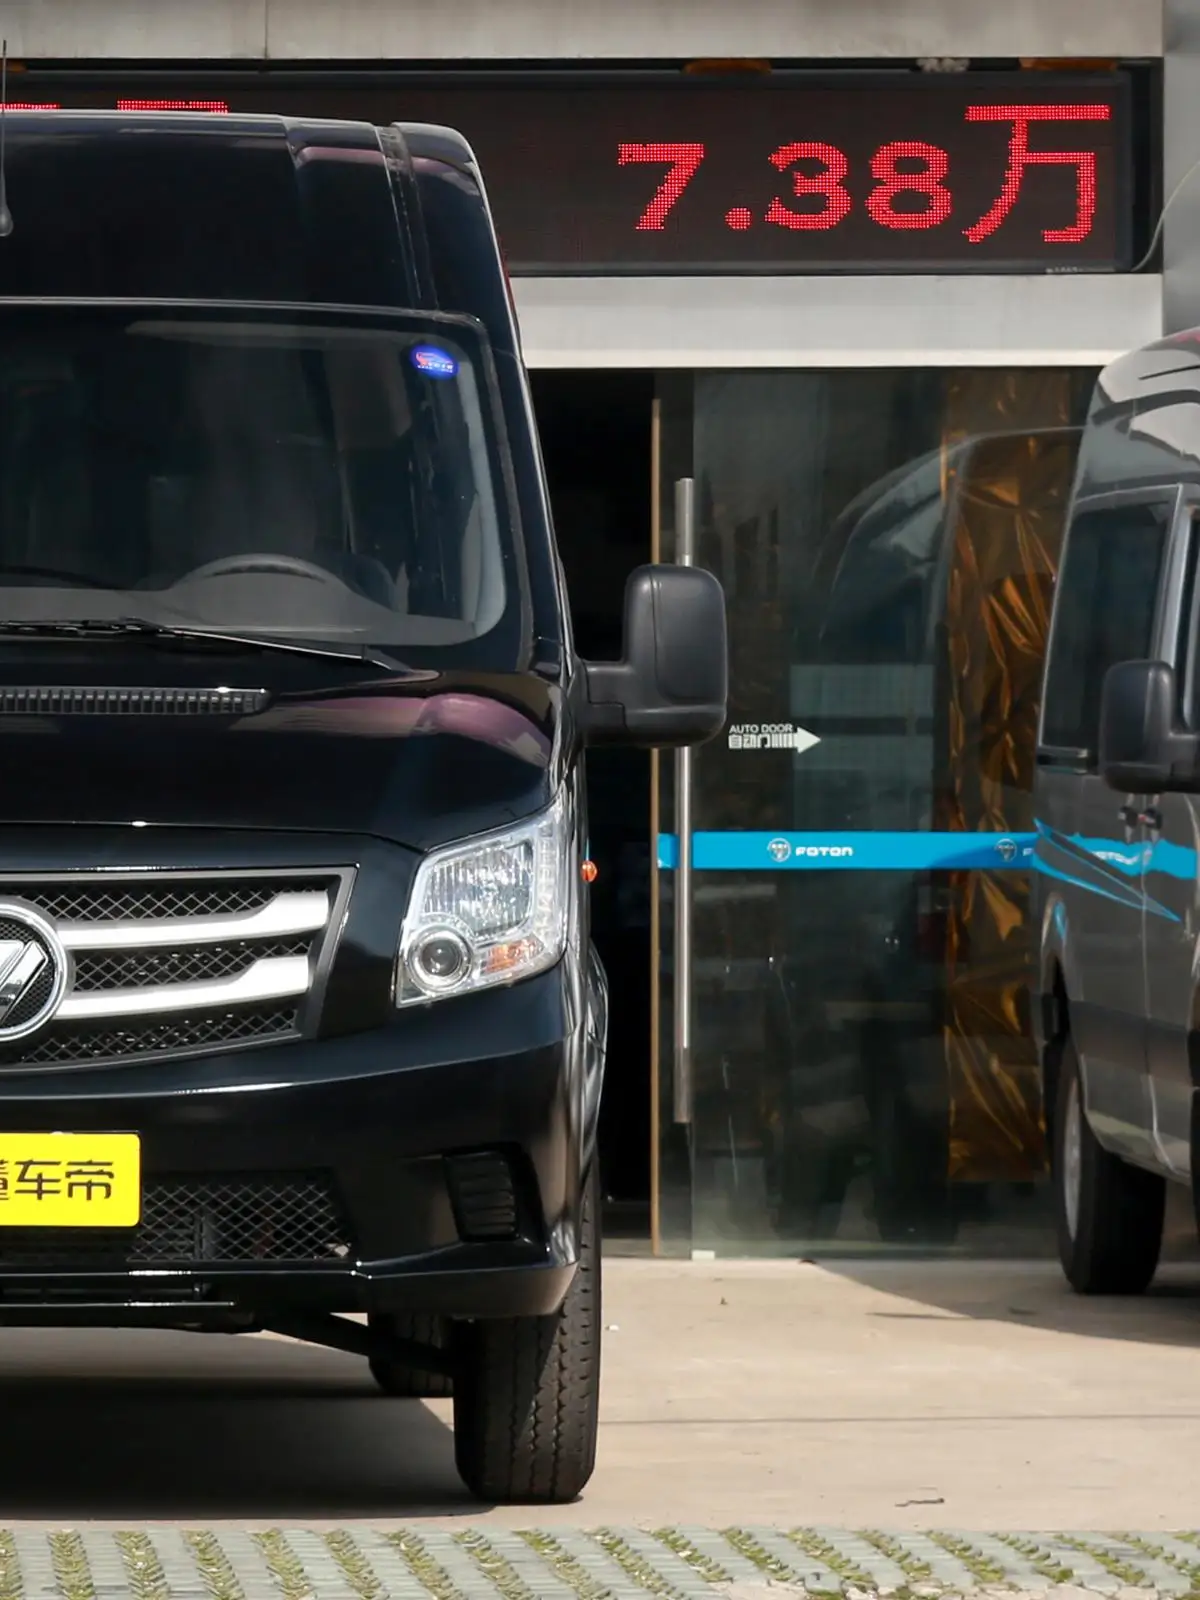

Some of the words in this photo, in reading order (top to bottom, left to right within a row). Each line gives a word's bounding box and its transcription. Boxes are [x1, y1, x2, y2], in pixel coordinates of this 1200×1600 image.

[617, 104, 1110, 243] 7.38万
[728, 724, 759, 734] AUTO
[760, 723, 793, 733] DOOR
[795, 846, 854, 857] FOTON
